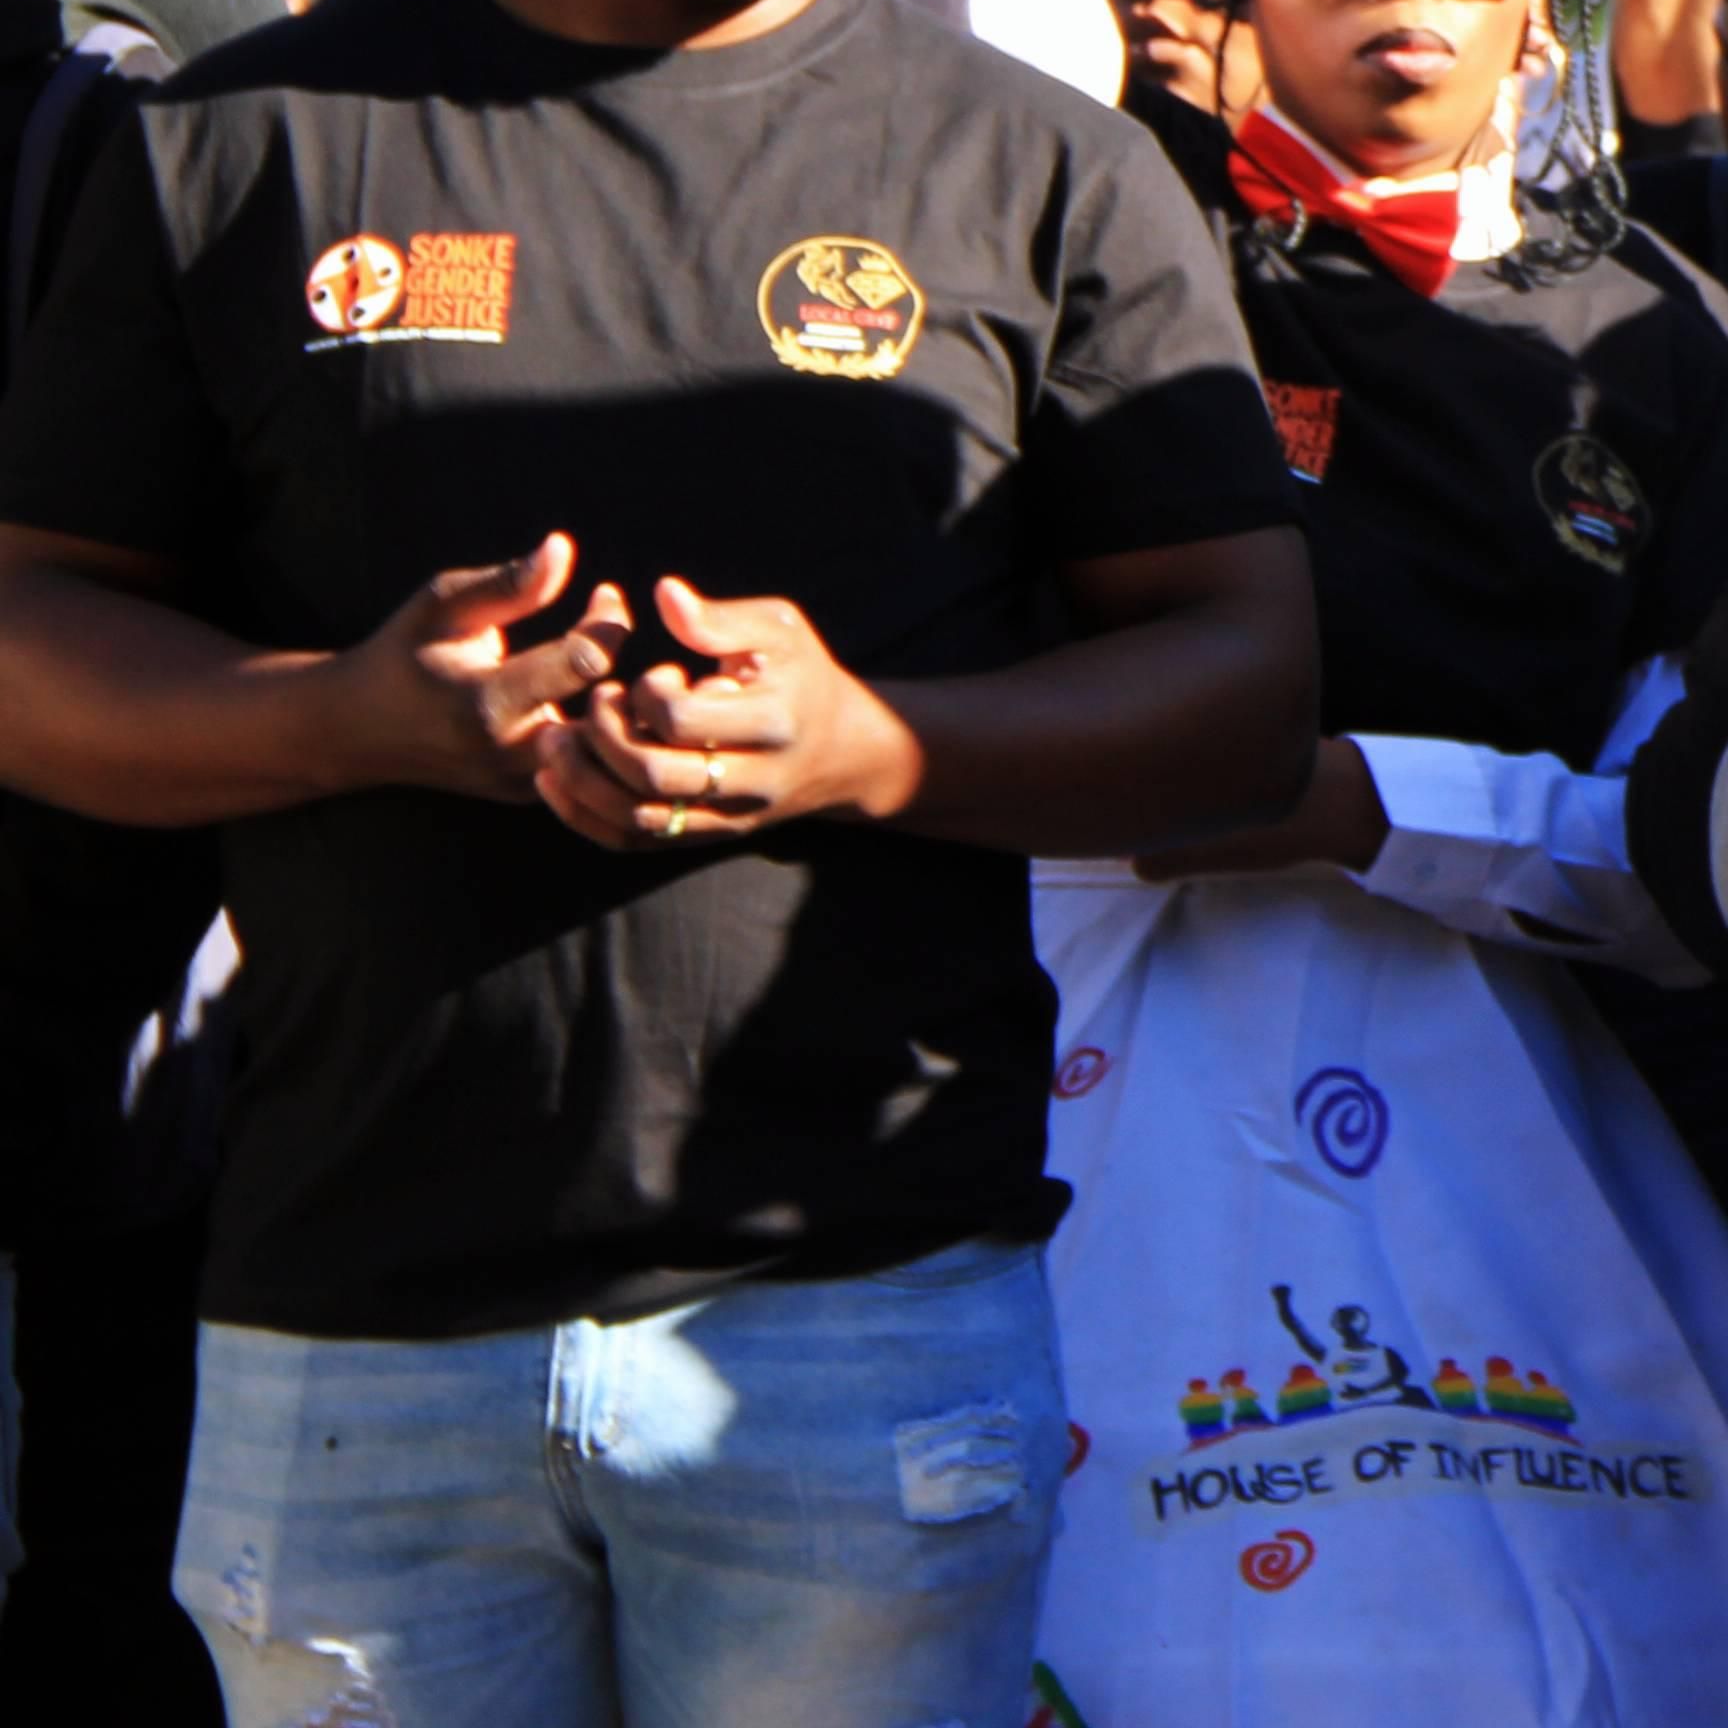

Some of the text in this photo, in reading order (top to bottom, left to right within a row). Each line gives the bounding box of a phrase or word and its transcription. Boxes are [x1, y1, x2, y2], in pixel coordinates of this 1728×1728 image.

[409, 232, 517, 268] SONKE
[406, 267, 512, 300] GENDER
[400, 297, 508, 332] JUSTICE
[1150, 1440, 1694, 1521] HOUSE OF INFLUENCE
